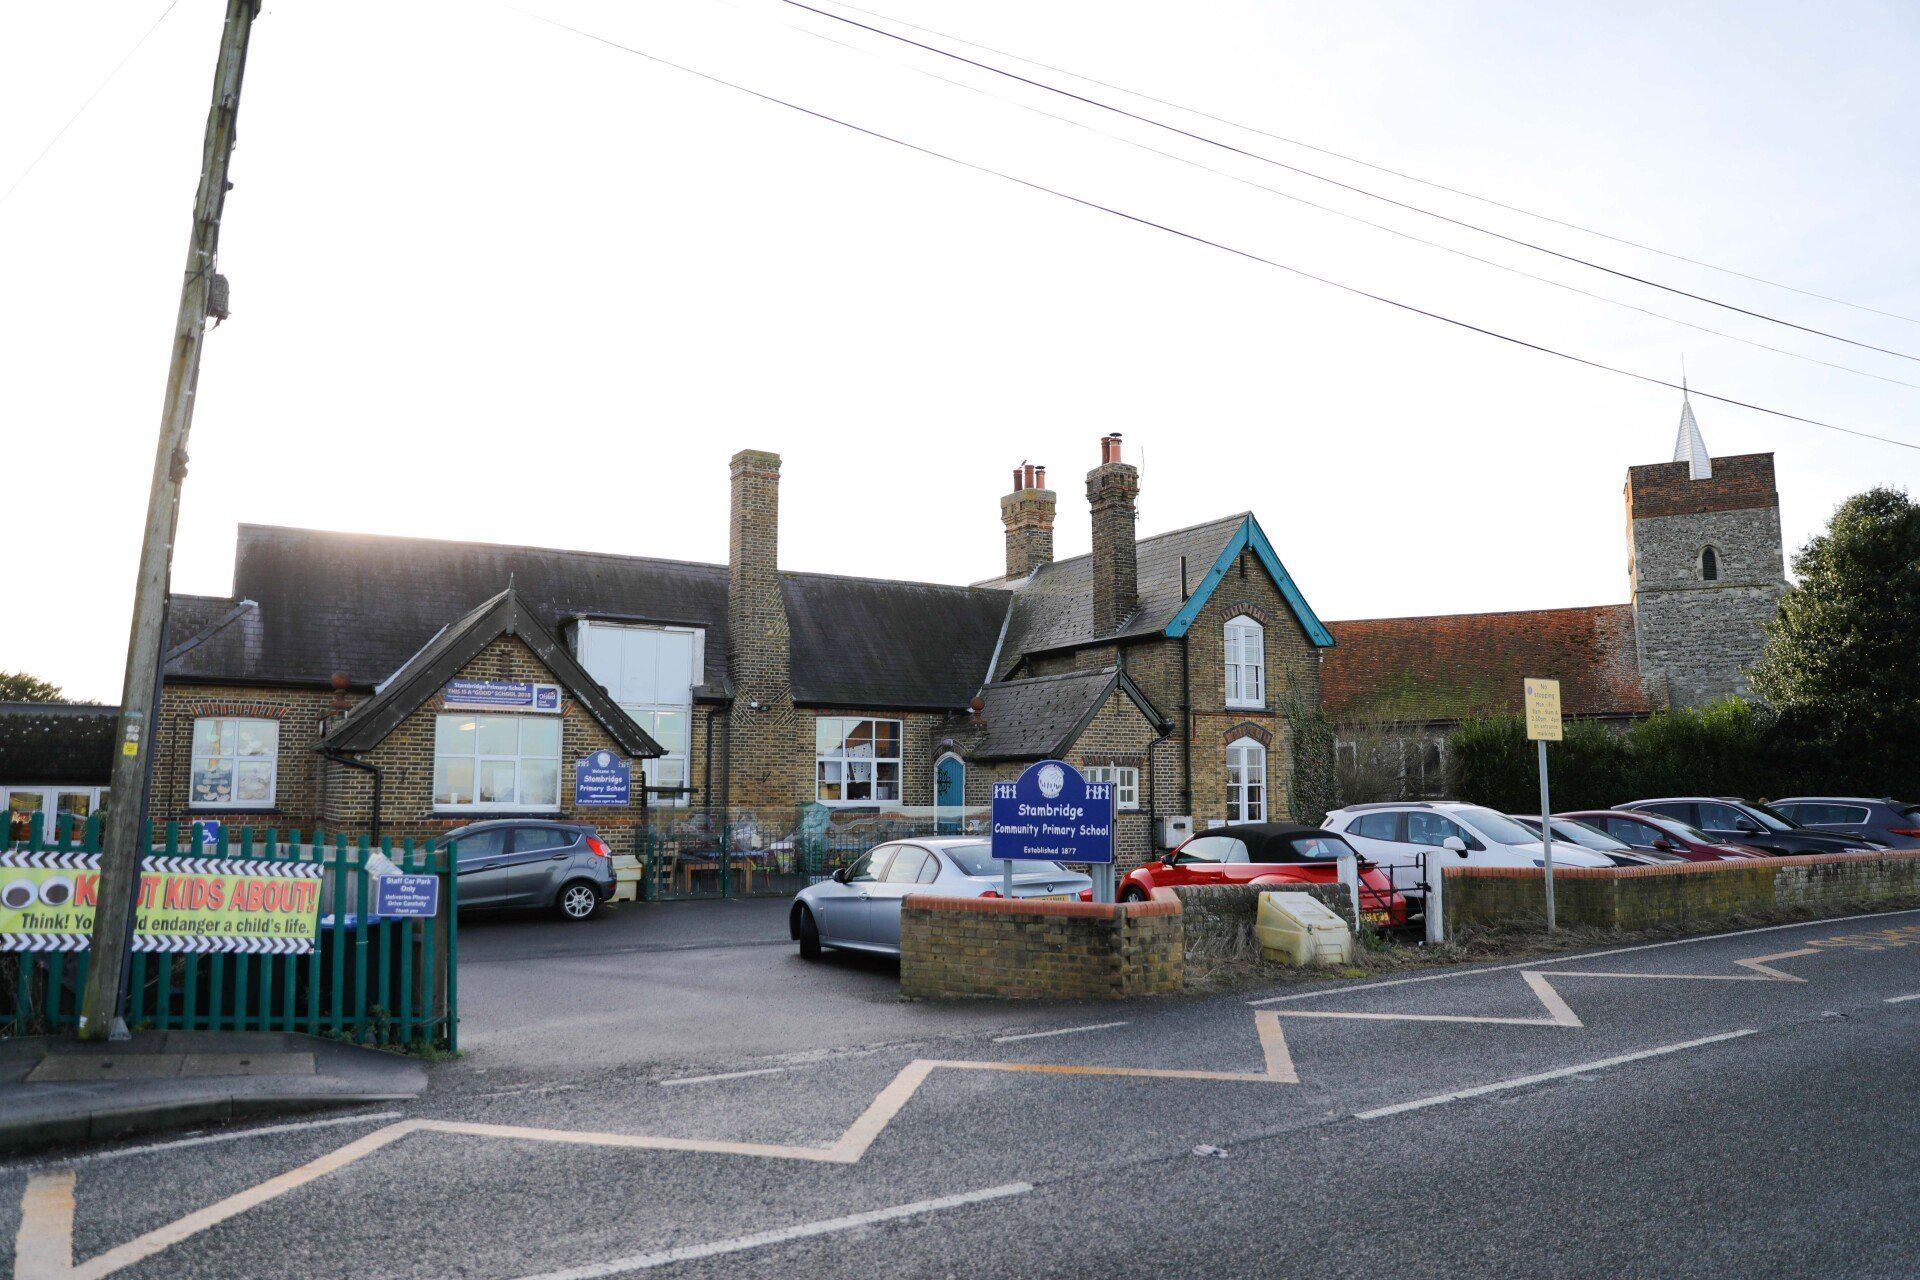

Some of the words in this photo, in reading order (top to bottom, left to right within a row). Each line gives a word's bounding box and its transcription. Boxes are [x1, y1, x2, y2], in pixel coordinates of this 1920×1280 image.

[454, 682, 486, 691] Stambridge
[584, 775, 622, 784] Stambridge
[1018, 804, 1084, 820] Stambridge
[994, 823, 1038, 838] Community
[1042, 824, 1076, 838] Primary
[1080, 825, 1109, 836] School
[1024, 846, 1058, 854] Established
[164, 876, 226, 910] KIDS
[228, 880, 318, 913] ABOUT!
[22, 913, 70, 929] Think!
[74, 914, 92, 930] Yo
[151, 918, 221, 934] endanger
[224, 920, 232, 932] a
[236, 919, 281, 933] child's
[284, 919, 310, 934] life.
